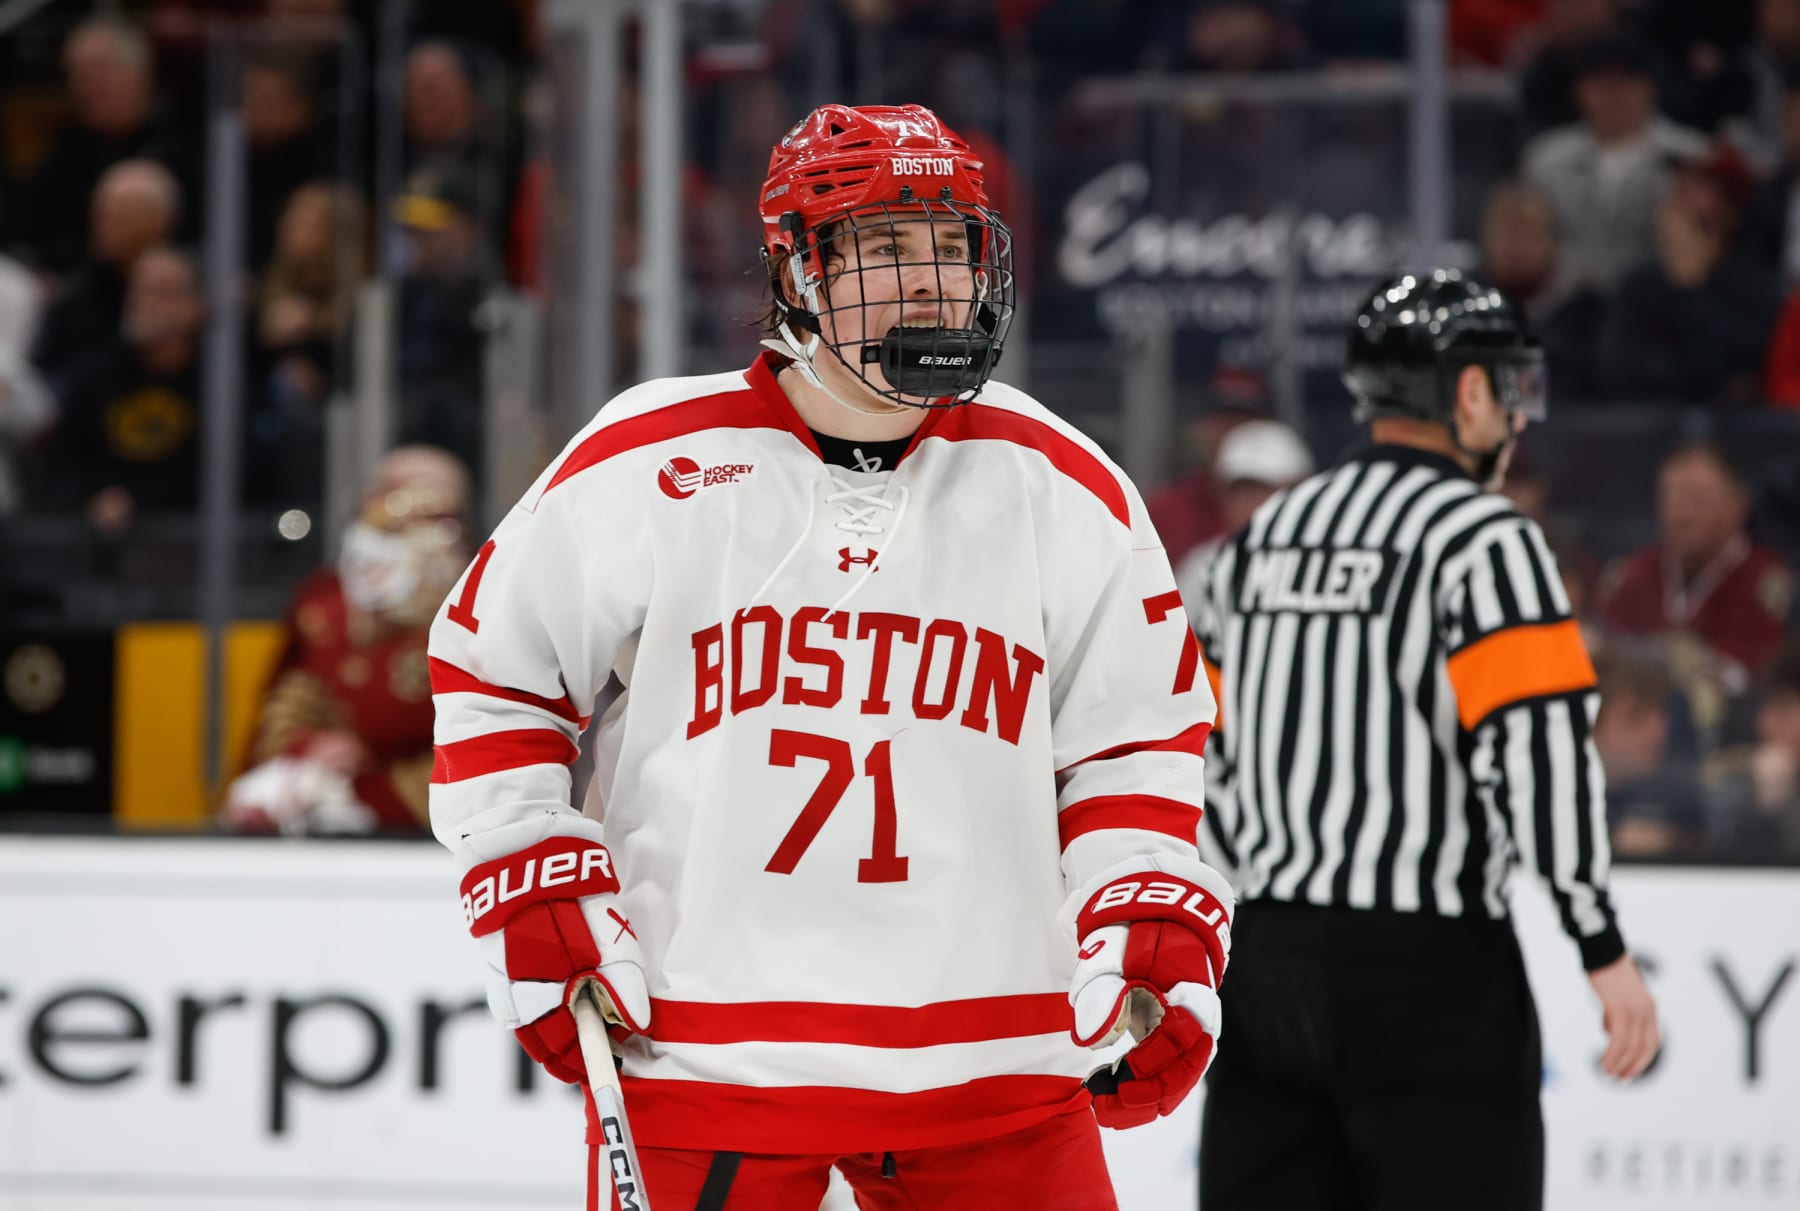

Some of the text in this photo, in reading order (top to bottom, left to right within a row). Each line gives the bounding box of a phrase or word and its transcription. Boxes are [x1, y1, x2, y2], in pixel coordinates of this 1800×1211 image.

[891, 157, 955, 176] BOSTON
[703, 473, 736, 487] EAST
[704, 464, 754, 477] HOCKEY
[1239, 550, 1384, 613] MILLER
[1142, 588, 1200, 696] 7
[686, 604, 1045, 746] BOSTON
[764, 728, 909, 883] 71
[602, 1116, 641, 1211] CCM
[1585, 1142, 1800, 1195] RETIRE
